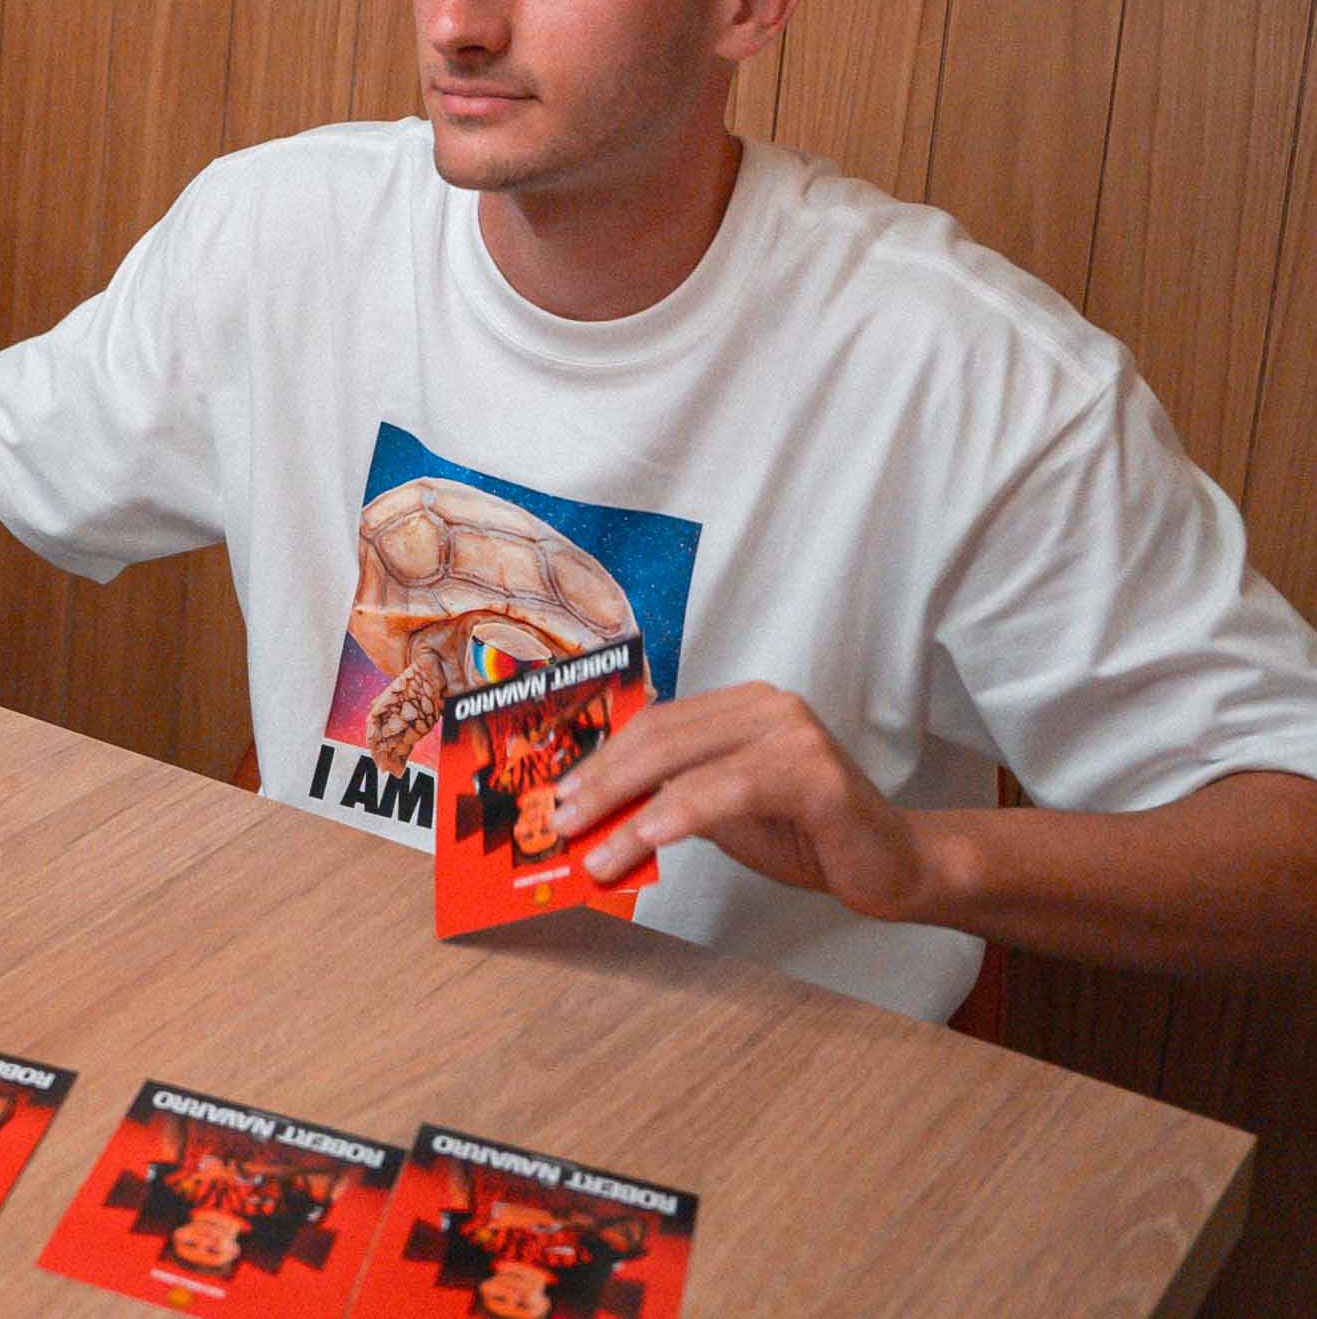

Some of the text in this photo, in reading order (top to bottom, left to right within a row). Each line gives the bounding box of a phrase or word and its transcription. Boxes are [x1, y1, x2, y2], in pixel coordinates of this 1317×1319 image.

[454, 644, 630, 721] ROBERT NAVARRO
[309, 744, 435, 829] I AM
[152, 1089, 385, 1170] ROBERT NAVARRO
[431, 1134, 678, 1218] ROBERT NAVARRO
